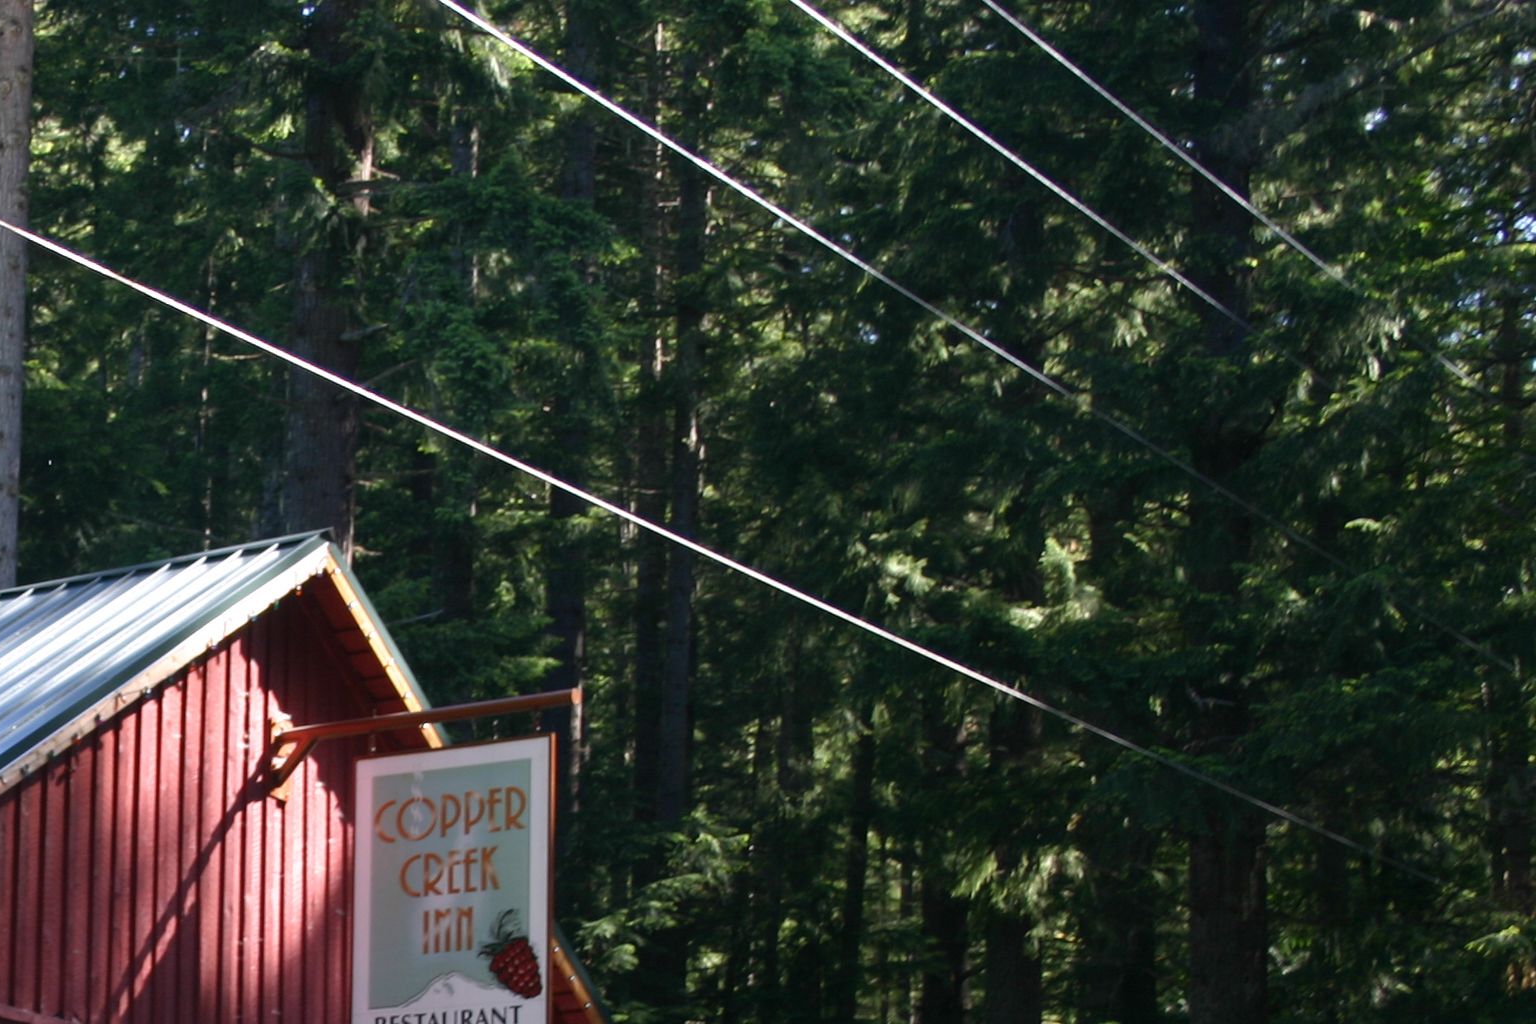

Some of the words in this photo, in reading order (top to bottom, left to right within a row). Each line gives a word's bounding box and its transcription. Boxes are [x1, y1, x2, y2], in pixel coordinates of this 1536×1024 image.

[374, 786, 527, 843] COPPER
[400, 846, 500, 897] CREEK
[422, 907, 474, 954] INN
